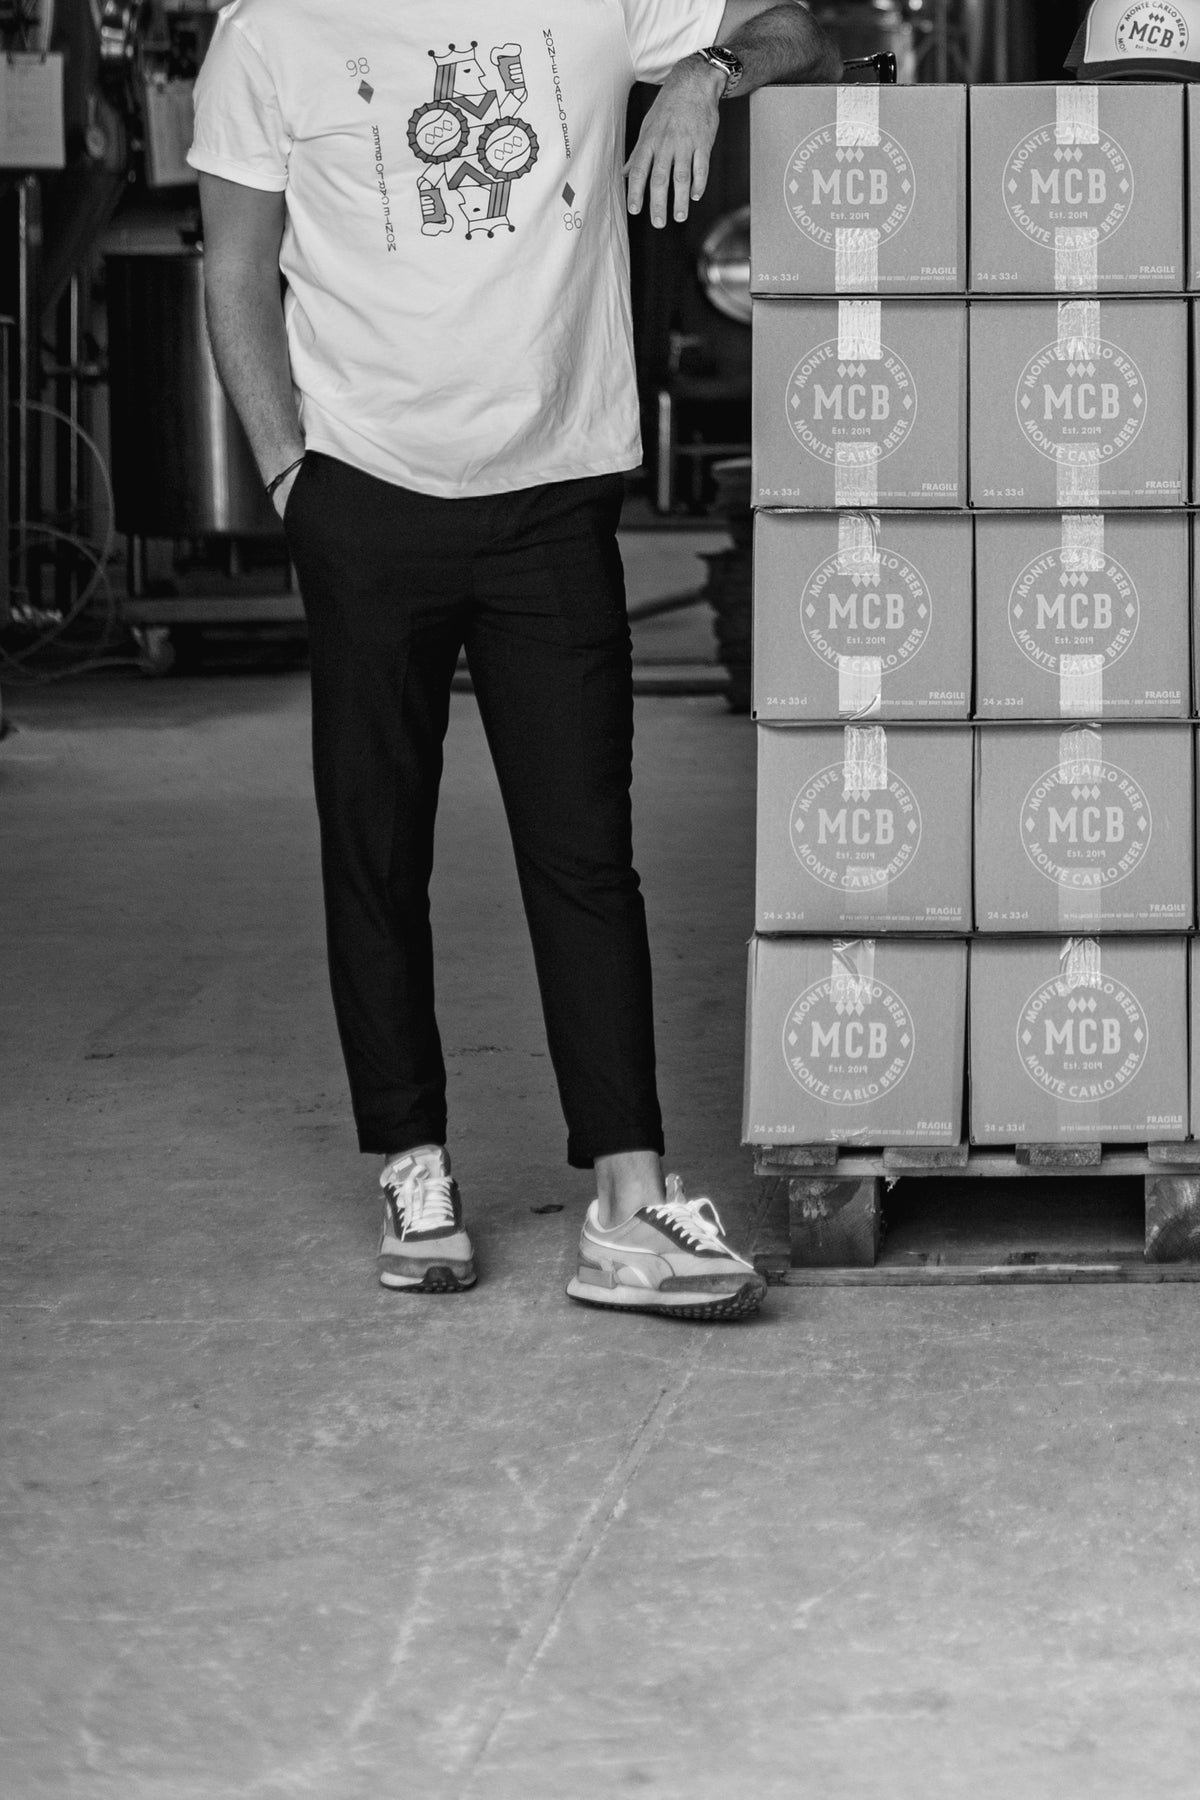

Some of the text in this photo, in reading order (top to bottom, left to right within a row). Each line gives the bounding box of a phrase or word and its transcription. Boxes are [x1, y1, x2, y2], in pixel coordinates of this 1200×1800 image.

[1124, 1, 1186, 37] MONTE CARLO BEER
[1128, 20, 1174, 48] MCB
[346, 57, 370, 77] 98
[542, 28, 572, 159] MONTE CARLO BEER
[371, 124, 397, 253] MONTE CARLO BEER
[811, 169, 888, 205] MCB
[1030, 168, 1106, 204] MCB
[830, 212, 870, 220] Est. 2019
[1049, 211, 1088, 219] Est. 2019
[921, 267, 956, 275] FRAGILE
[1140, 266, 1175, 274] FRAGILE
[813, 384, 889, 420] MCB
[1043, 384, 1119, 419] MCB
[922, 483, 957, 491] FRAGILE
[1146, 481, 1181, 489] FRAGILE
[828, 594, 904, 629] MCB
[1036, 594, 1112, 629] MCB
[930, 691, 965, 699] FRAGILE
[1145, 691, 1180, 699] FRAGILE
[817, 808, 894, 844] MCB
[1048, 807, 1124, 843] MCB
[926, 907, 961, 915] FRAGILE
[1150, 904, 1185, 912] FRAGILE
[810, 1022, 887, 1058] MCB
[1044, 1019, 1121, 1054] MCB
[917, 1122, 952, 1130] FRAGILE
[1147, 1115, 1182, 1123] FRAGILE
